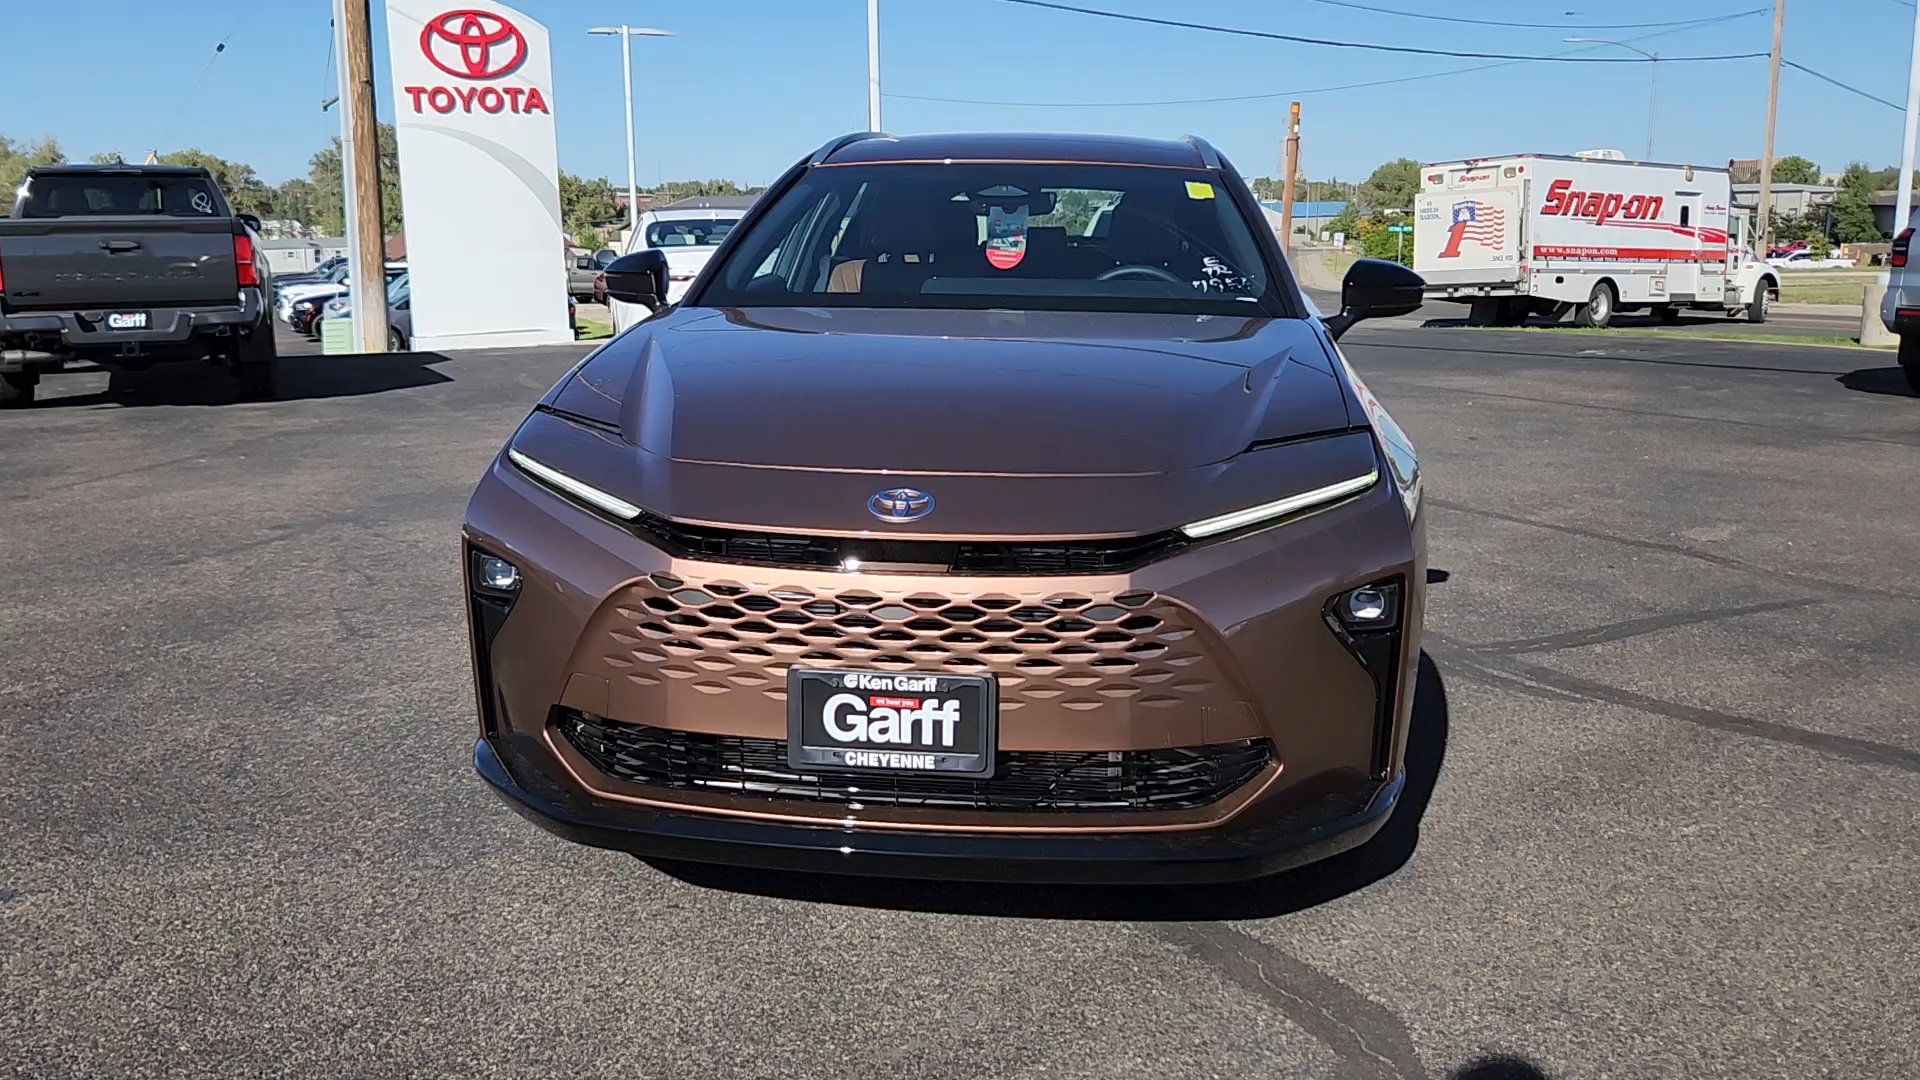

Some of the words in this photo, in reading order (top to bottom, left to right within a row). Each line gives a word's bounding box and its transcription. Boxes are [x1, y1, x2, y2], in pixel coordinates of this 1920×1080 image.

[404, 86, 549, 114] TOYOTA
[1458, 175, 1490, 183] Snap-on
[1540, 179, 1663, 226] Snap-on
[1540, 247, 1618, 256] www.snapon.com
[109, 312, 147, 328] Garff
[859, 674, 893, 691] Ken
[894, 676, 938, 693] Garff
[822, 693, 961, 747] Garff
[844, 752, 936, 769] CHEYENNE
